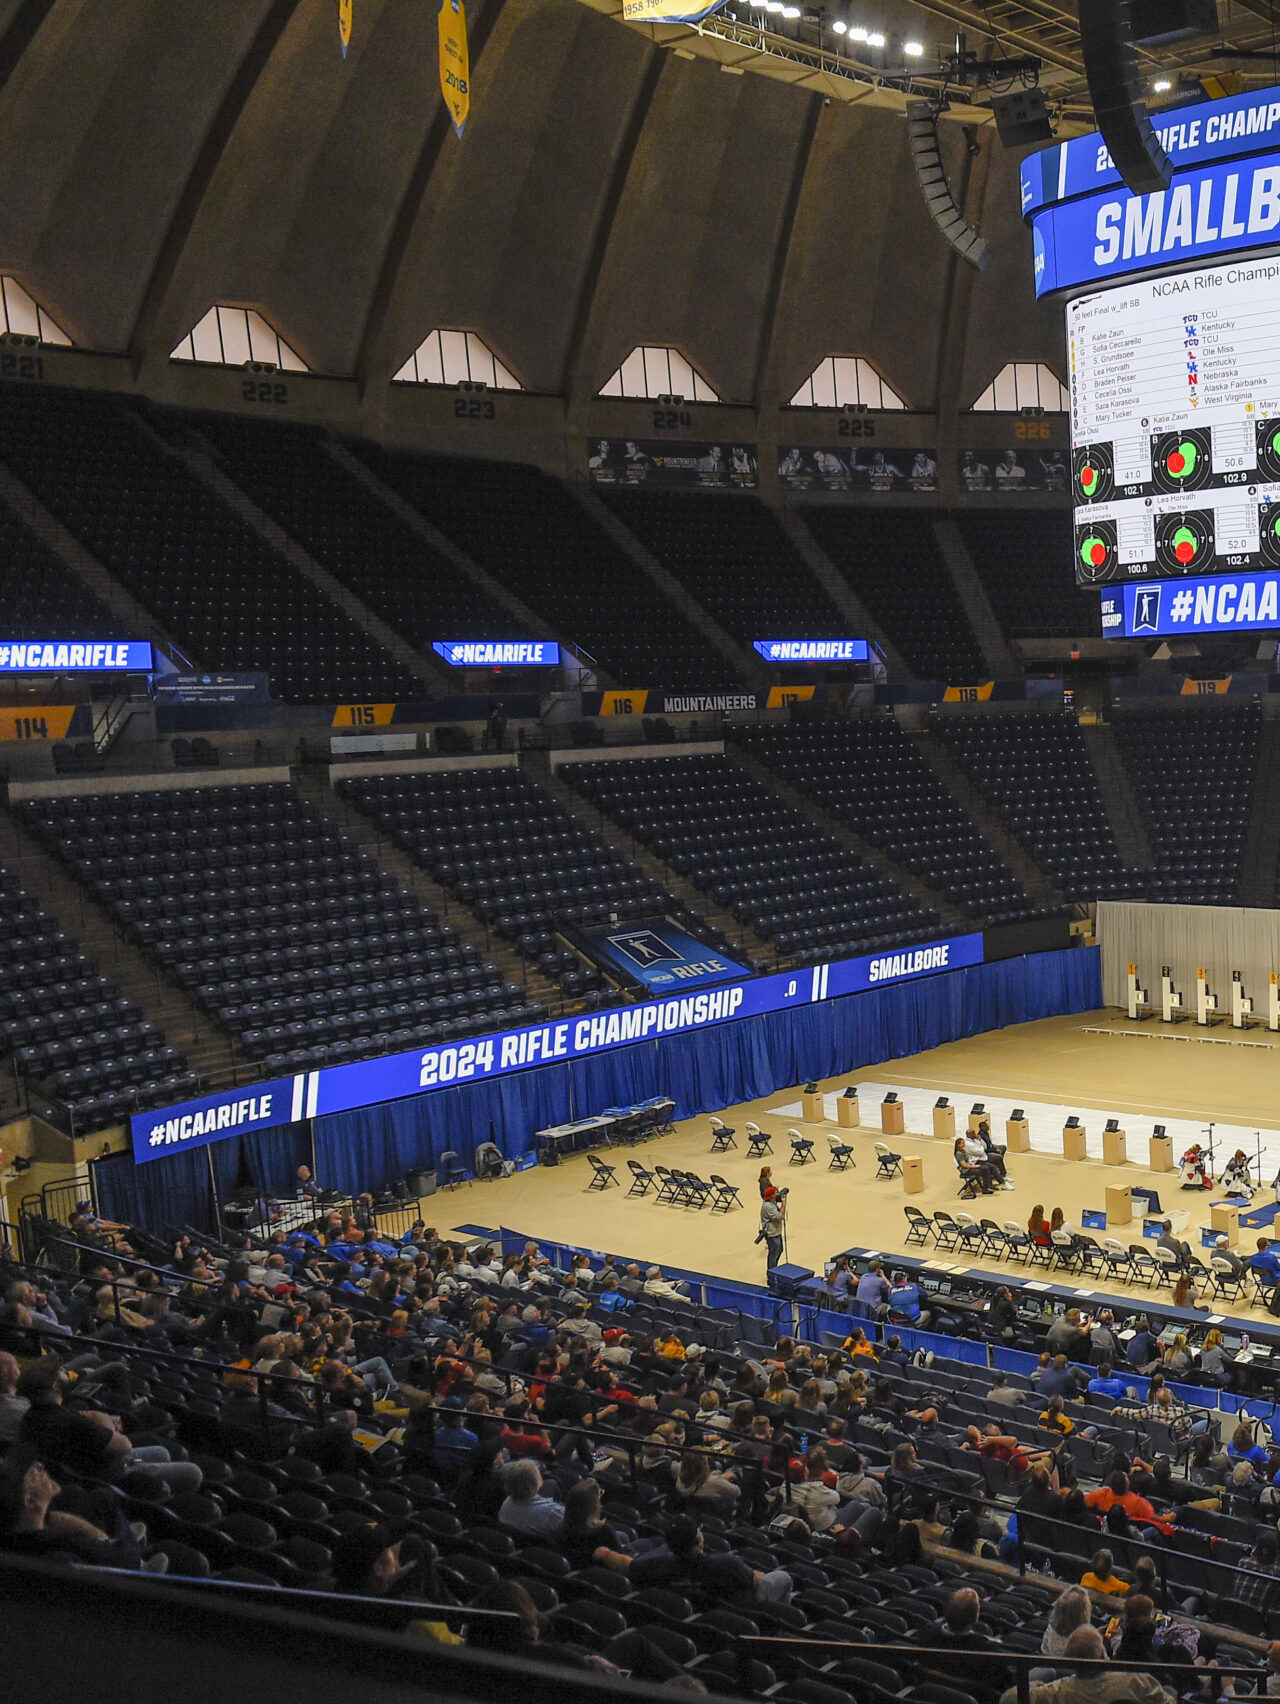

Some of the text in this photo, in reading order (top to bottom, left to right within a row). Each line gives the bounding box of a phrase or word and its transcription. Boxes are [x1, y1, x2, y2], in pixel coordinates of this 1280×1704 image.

[1152, 283, 1190, 297] NCAA
[1194, 274, 1223, 290] Rifle
[1094, 306, 1109, 316] Final
[1130, 299, 1140, 307] SB
[1092, 332, 1107, 341] Katie
[1108, 329, 1124, 338] Zaun
[1201, 311, 1217, 320] TCU
[1093, 343, 1107, 353] Sofia
[1108, 337, 1141, 350] Ceccarello
[1201, 321, 1235, 333] Kentucky
[1093, 356, 1099, 365] S.
[1100, 351, 1134, 363] Grundsoee
[1202, 335, 1219, 344] TCU
[1094, 368, 1104, 376] Lea
[1106, 363, 1130, 374] Horvath
[1202, 348, 1216, 357] Ole
[1217, 345, 1234, 354] Miss
[1094, 378, 1115, 388] Braden
[1116, 373, 1136, 384] Peiser
[1203, 357, 1237, 369] Kentucky
[242, 380, 289, 404] 222
[1094, 389, 1117, 400] Cecelia
[1118, 386, 1132, 395] Ossi
[1203, 369, 1238, 381] Nebraska
[1095, 402, 1109, 411] Sara
[1110, 397, 1139, 408] Karasova
[1204, 383, 1229, 393] Alaska
[1230, 377, 1267, 389] Fairbanks
[454, 400, 496, 420] 223
[1095, 414, 1109, 424] Mary
[1112, 410, 1132, 419] Tucker
[1205, 396, 1223, 405] West
[1224, 391, 1252, 403] Virginia
[653, 411, 691, 429] 224
[837, 419, 876, 437] 225
[1015, 421, 1050, 438] 226
[1223, 474, 1247, 483] 102.9
[0, 644, 129, 668] #NCAARIFLE
[450, 643, 544, 663] #NCAARIFLE
[770, 642, 853, 659] #NCAARIFLE
[664, 695, 757, 713] MOUNTAINEERS
[959, 688, 978, 701] 118
[349, 707, 375, 725] 115
[613, 697, 634, 715] 116
[14, 717, 48, 739] 114
[673, 958, 728, 980] RIFLE
[869, 945, 949, 982] SMALLBORE
[419, 1040, 494, 1087] 2024
[500, 1024, 569, 1068] RIFLE
[573, 986, 744, 1051] CHAMPIONSHIP
[149, 1094, 272, 1147] #NCAARIFLE
